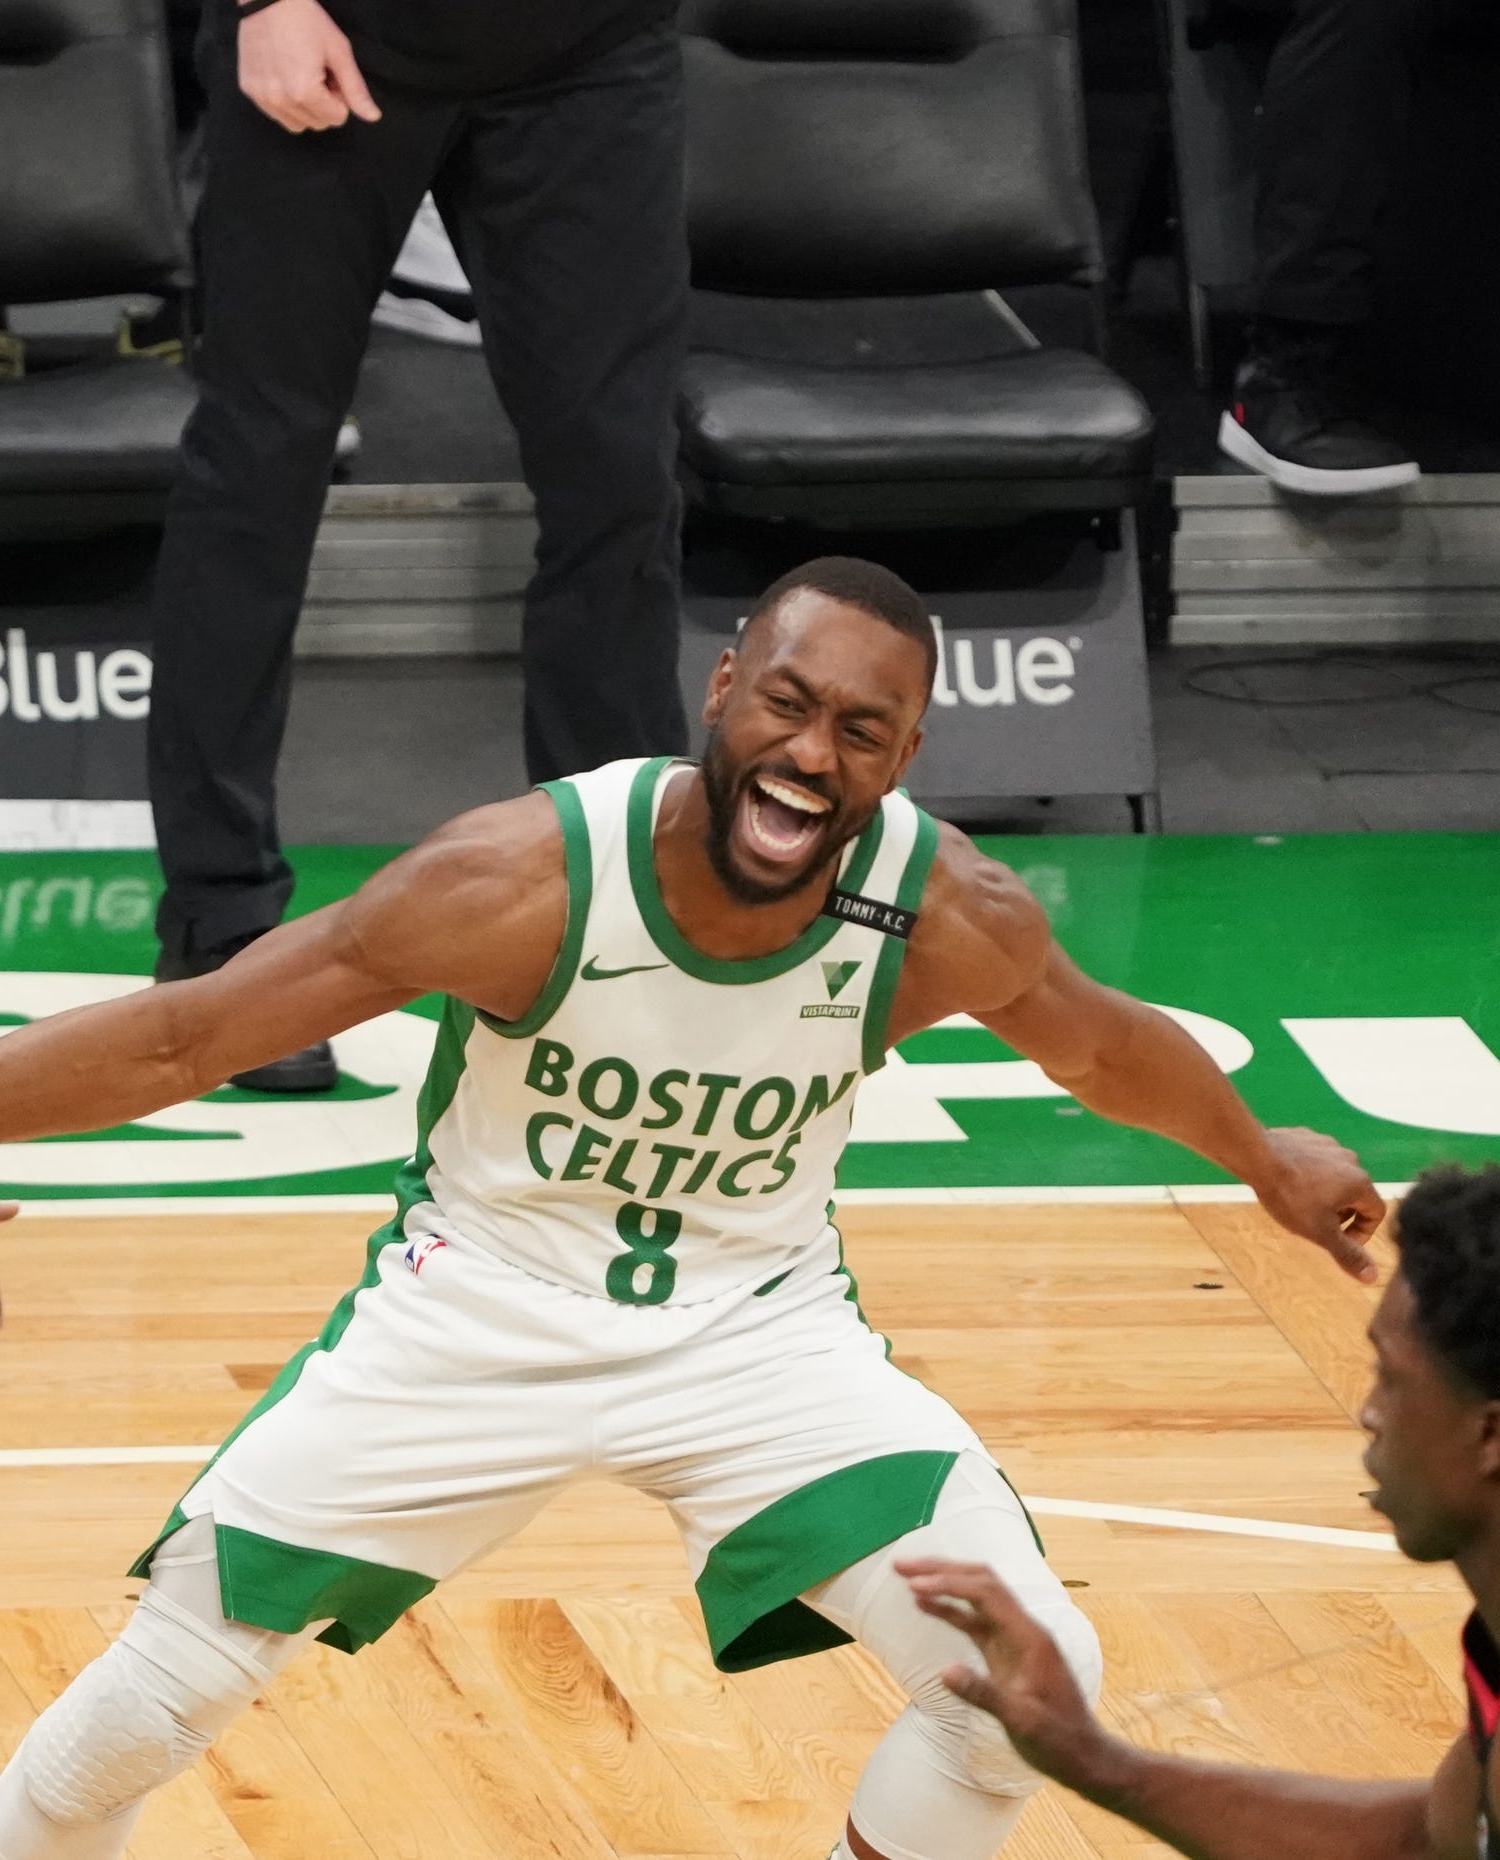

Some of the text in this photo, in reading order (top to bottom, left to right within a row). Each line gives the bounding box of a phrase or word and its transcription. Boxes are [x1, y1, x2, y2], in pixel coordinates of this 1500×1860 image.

[834, 895, 877, 921] TOMMY
[801, 1005, 860, 1018] VISTAPRINT
[523, 1036, 858, 1141] BOSTON
[525, 1111, 803, 1199] CELTICS
[605, 1200, 683, 1306] 8
